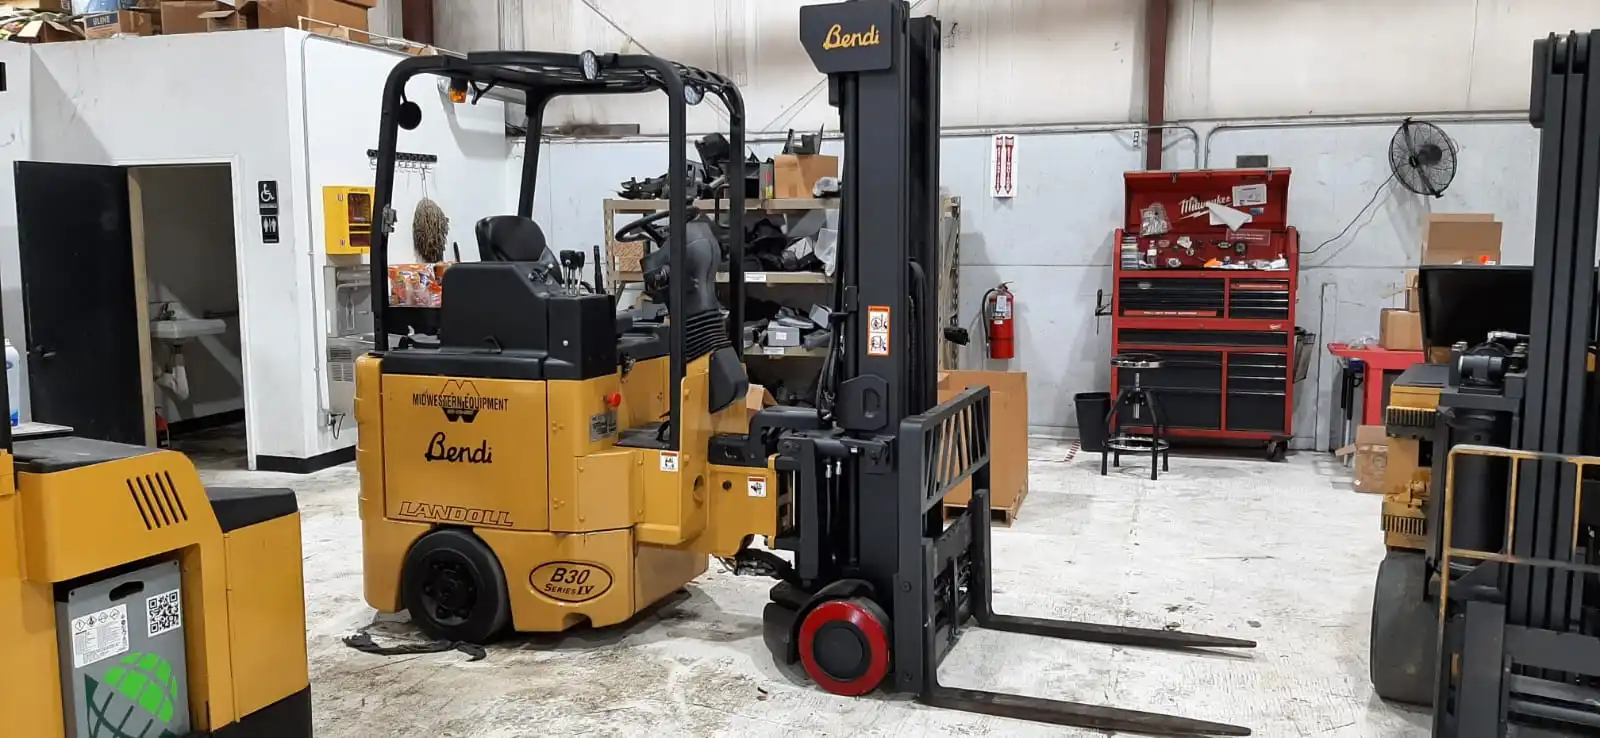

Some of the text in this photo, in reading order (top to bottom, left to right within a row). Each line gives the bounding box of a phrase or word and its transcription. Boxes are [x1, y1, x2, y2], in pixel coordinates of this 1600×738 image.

[823, 24, 879, 50] Bendi
[412, 393, 508, 411] MIDWESTERN EQUIPMENT
[424, 431, 492, 463] Bendi
[399, 501, 513, 526] LANDOLL
[550, 567, 590, 585] B30
[577, 585, 594, 595] IV
